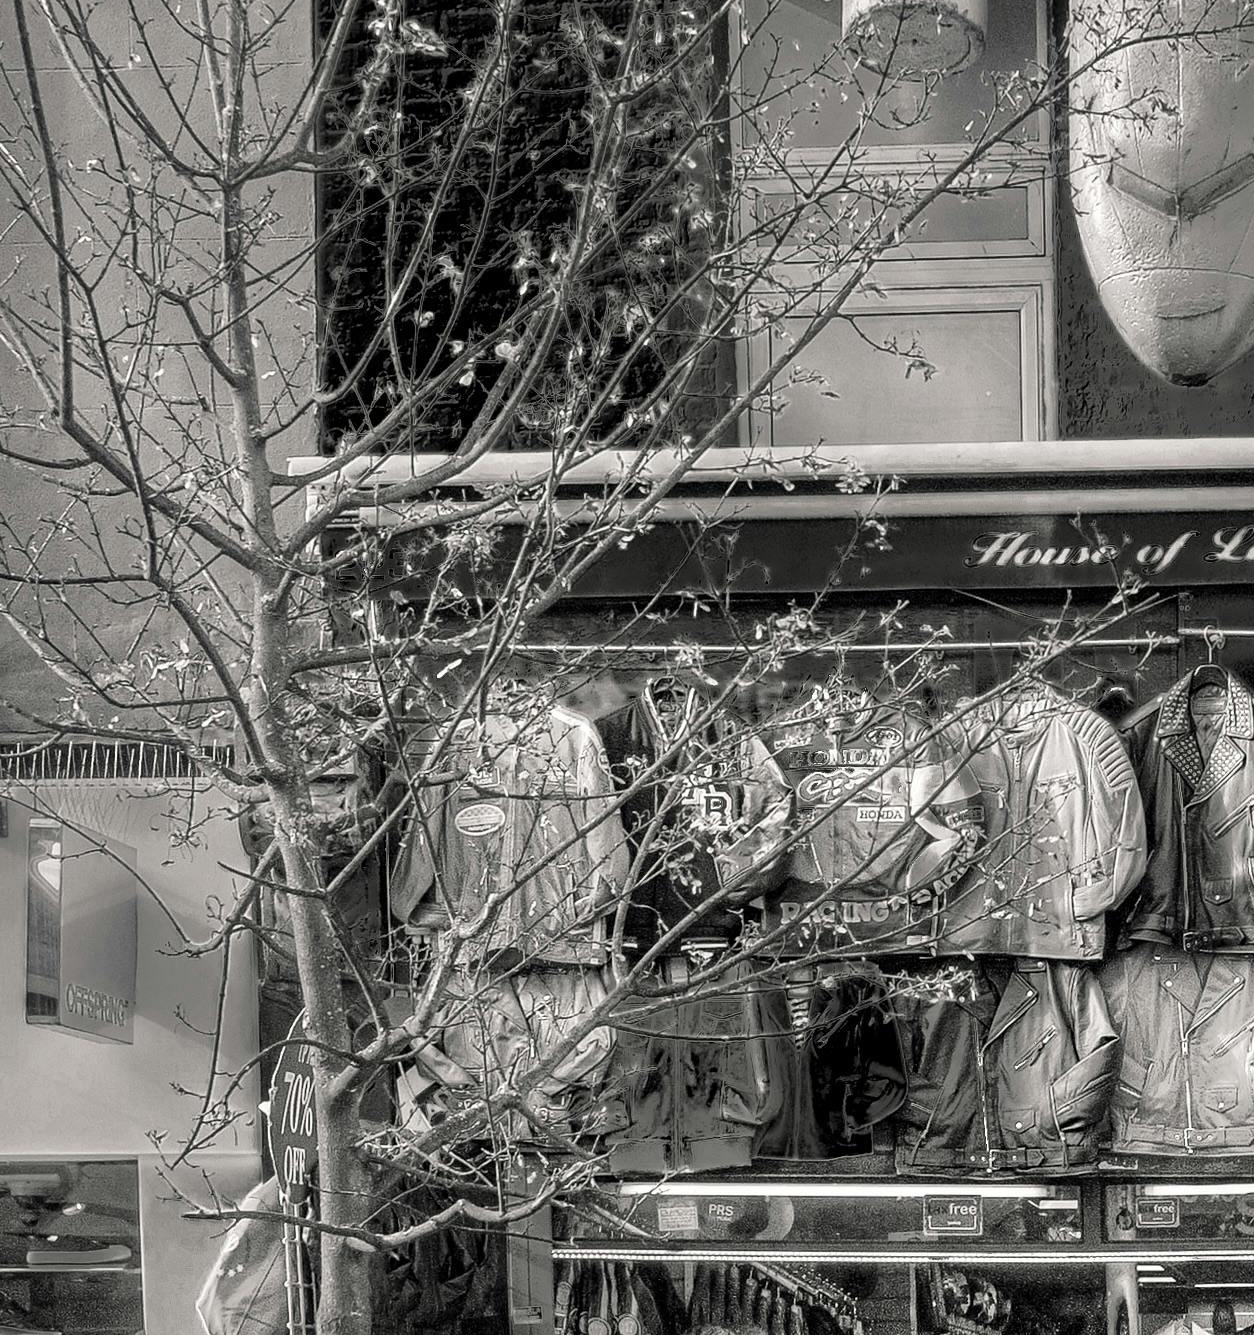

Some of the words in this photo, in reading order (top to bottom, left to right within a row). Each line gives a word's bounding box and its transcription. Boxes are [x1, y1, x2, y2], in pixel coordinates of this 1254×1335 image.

[963, 529, 1120, 569] House
[1136, 529, 1200, 576] of
[858, 808, 905, 821] HONDA
[65, 982, 126, 1027] OFFSPRING
[281, 1071, 316, 1138] 70%
[283, 1144, 306, 1186] OFF
[708, 1204, 734, 1216] PRS
[949, 1202, 977, 1215] free
[1153, 1204, 1175, 1214] free
